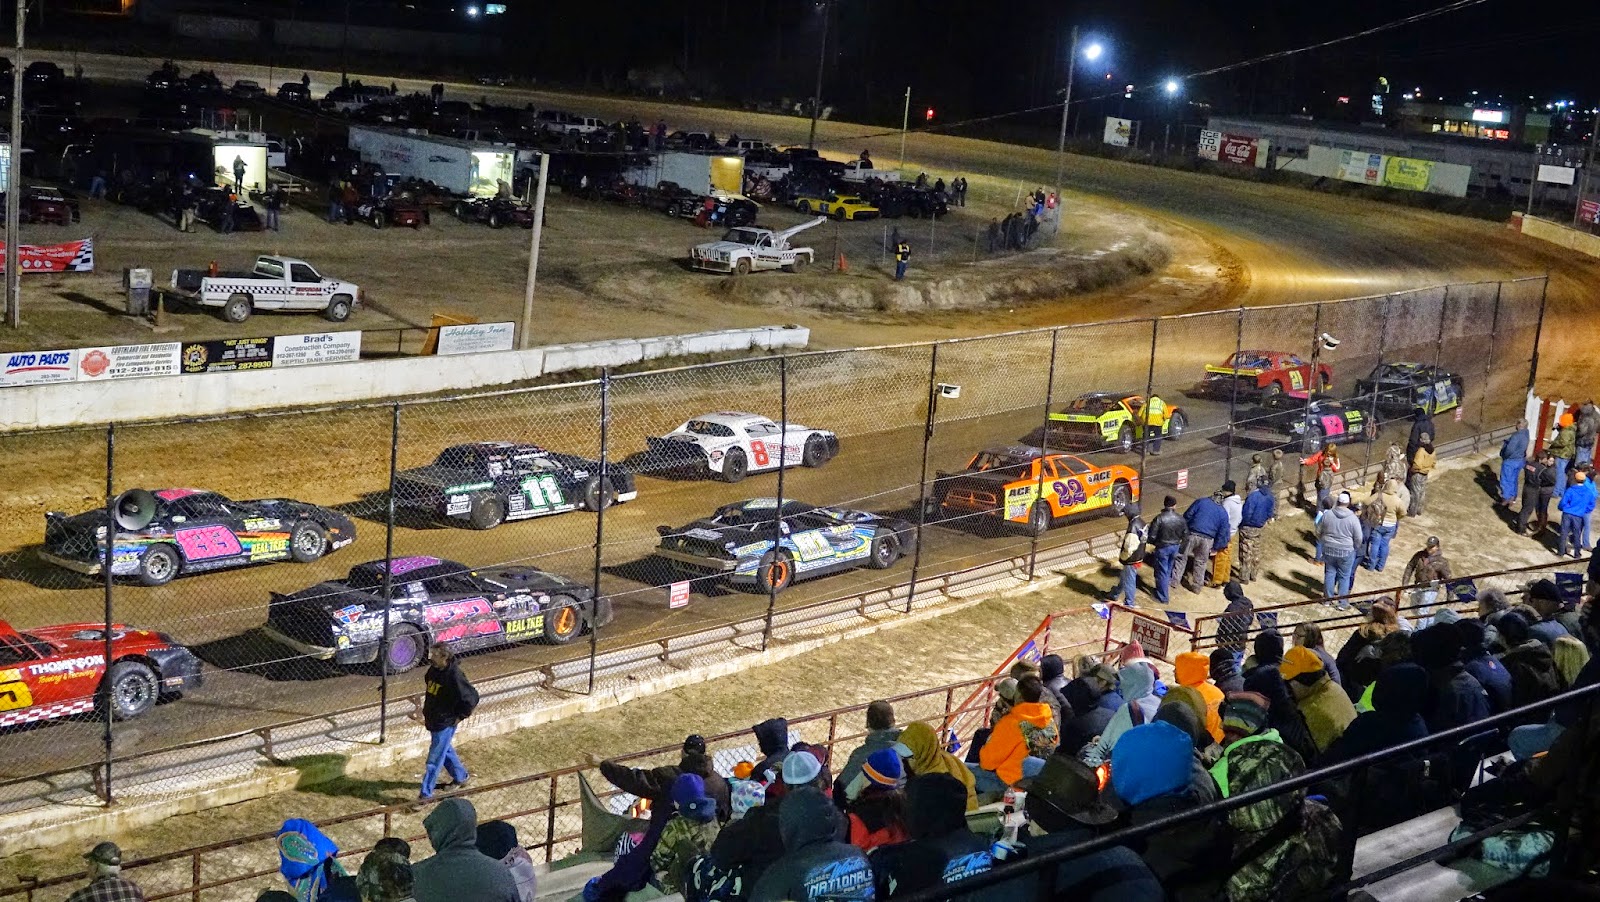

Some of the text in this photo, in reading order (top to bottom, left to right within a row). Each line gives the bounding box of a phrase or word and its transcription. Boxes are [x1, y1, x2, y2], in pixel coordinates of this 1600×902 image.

[304, 334, 333, 343] Brad's
[445, 325, 506, 337] Holiday Inn
[111, 343, 179, 355] SOUTHLAND FIRE PROTECTION
[284, 342, 351, 352] Construction Company
[6, 352, 71, 368] AUTO PARTS
[750, 439, 770, 467] 8
[1093, 470, 1111, 482] ACE
[520, 474, 565, 509] 11
[1052, 478, 1088, 509] 22
[251, 539, 287, 554] REAL TREE
[506, 615, 544, 633] REAL TREE
[1134, 617, 1166, 635] SECTIONS
[1137, 626, 1144, 634] A
[1153, 632, 1161, 640] B
[28, 655, 105, 676] THOMPSON
[38, 673, 63, 684] Towing
[67, 669, 97, 680] Recovery
[808, 869, 873, 899] NATIONALS
